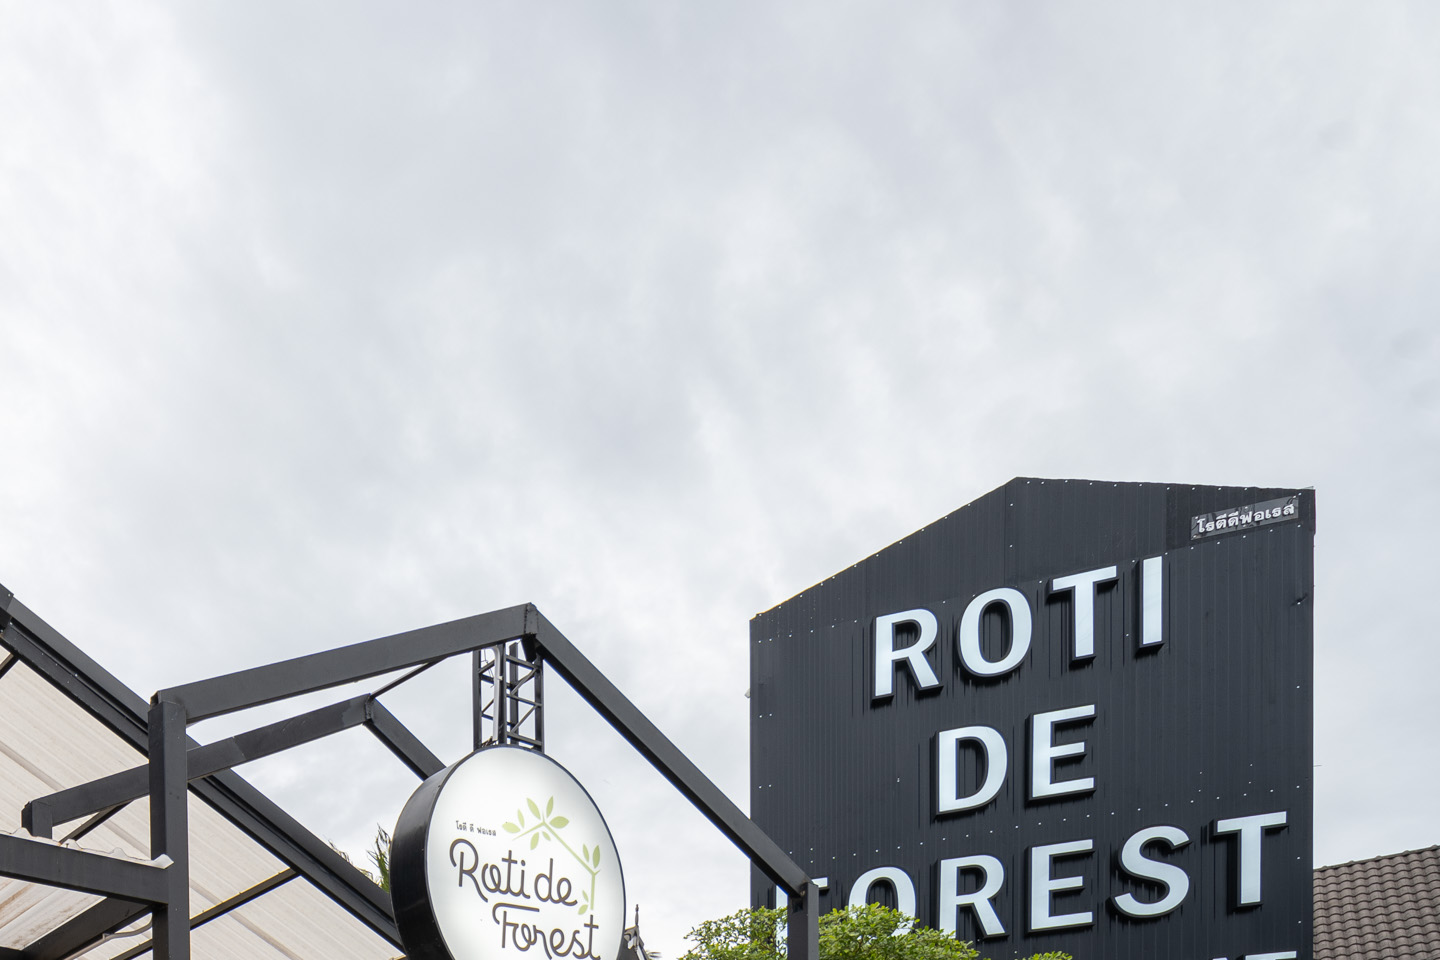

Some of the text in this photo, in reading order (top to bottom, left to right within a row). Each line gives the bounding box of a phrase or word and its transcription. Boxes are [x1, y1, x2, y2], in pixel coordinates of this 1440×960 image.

[874, 556, 1163, 697] ROTI
[938, 704, 1095, 813] DE
[449, 838, 578, 906] Roti de
[492, 902, 601, 960] Forest
